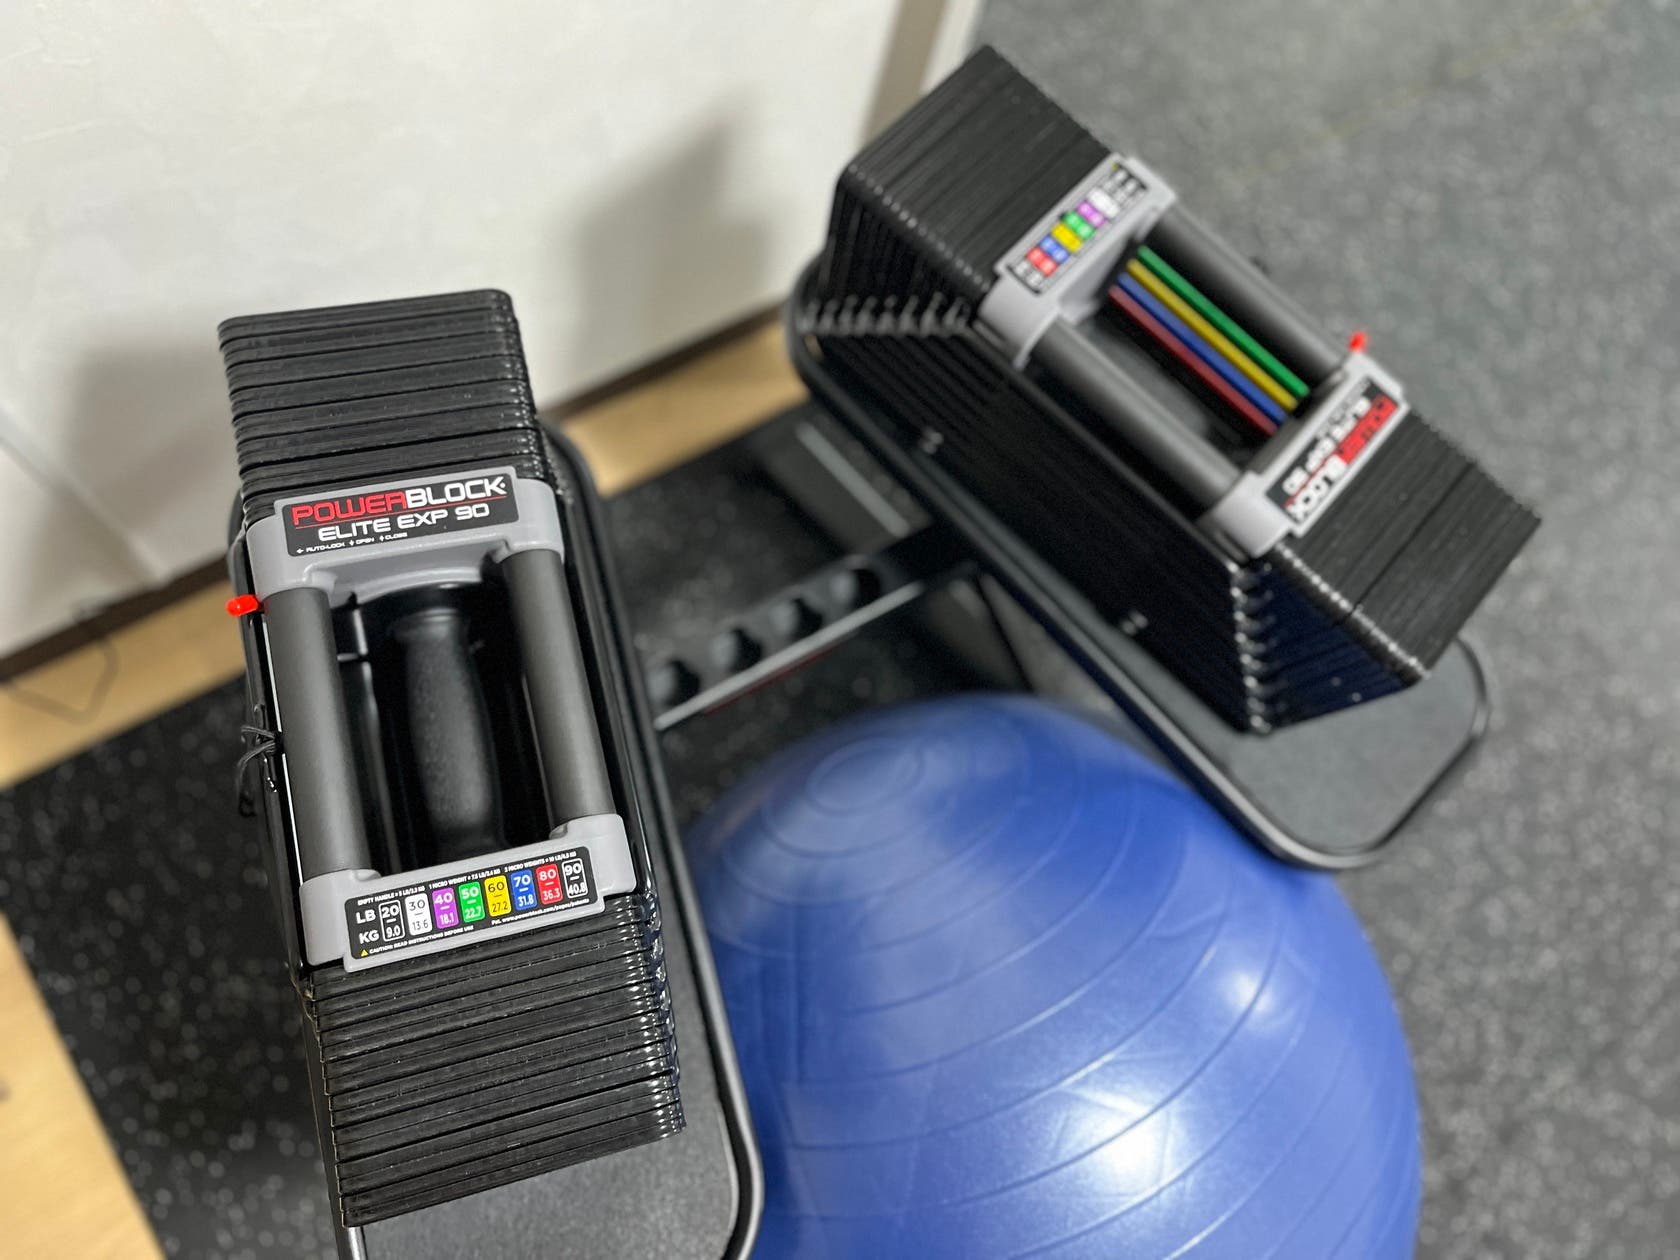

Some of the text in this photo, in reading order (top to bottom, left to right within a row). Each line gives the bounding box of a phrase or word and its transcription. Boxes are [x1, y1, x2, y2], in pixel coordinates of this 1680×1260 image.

[291, 476, 507, 525] POWERBLOCK
[318, 503, 490, 541] ELITE EXP 90
[385, 532, 408, 540] CLOSE
[356, 863, 582, 924] LB 20 30 40 50 60 70 80 90
[359, 882, 587, 944] KG 9.0 13.6 18.1 22.7 27.2 31.8 36.3 40.8
